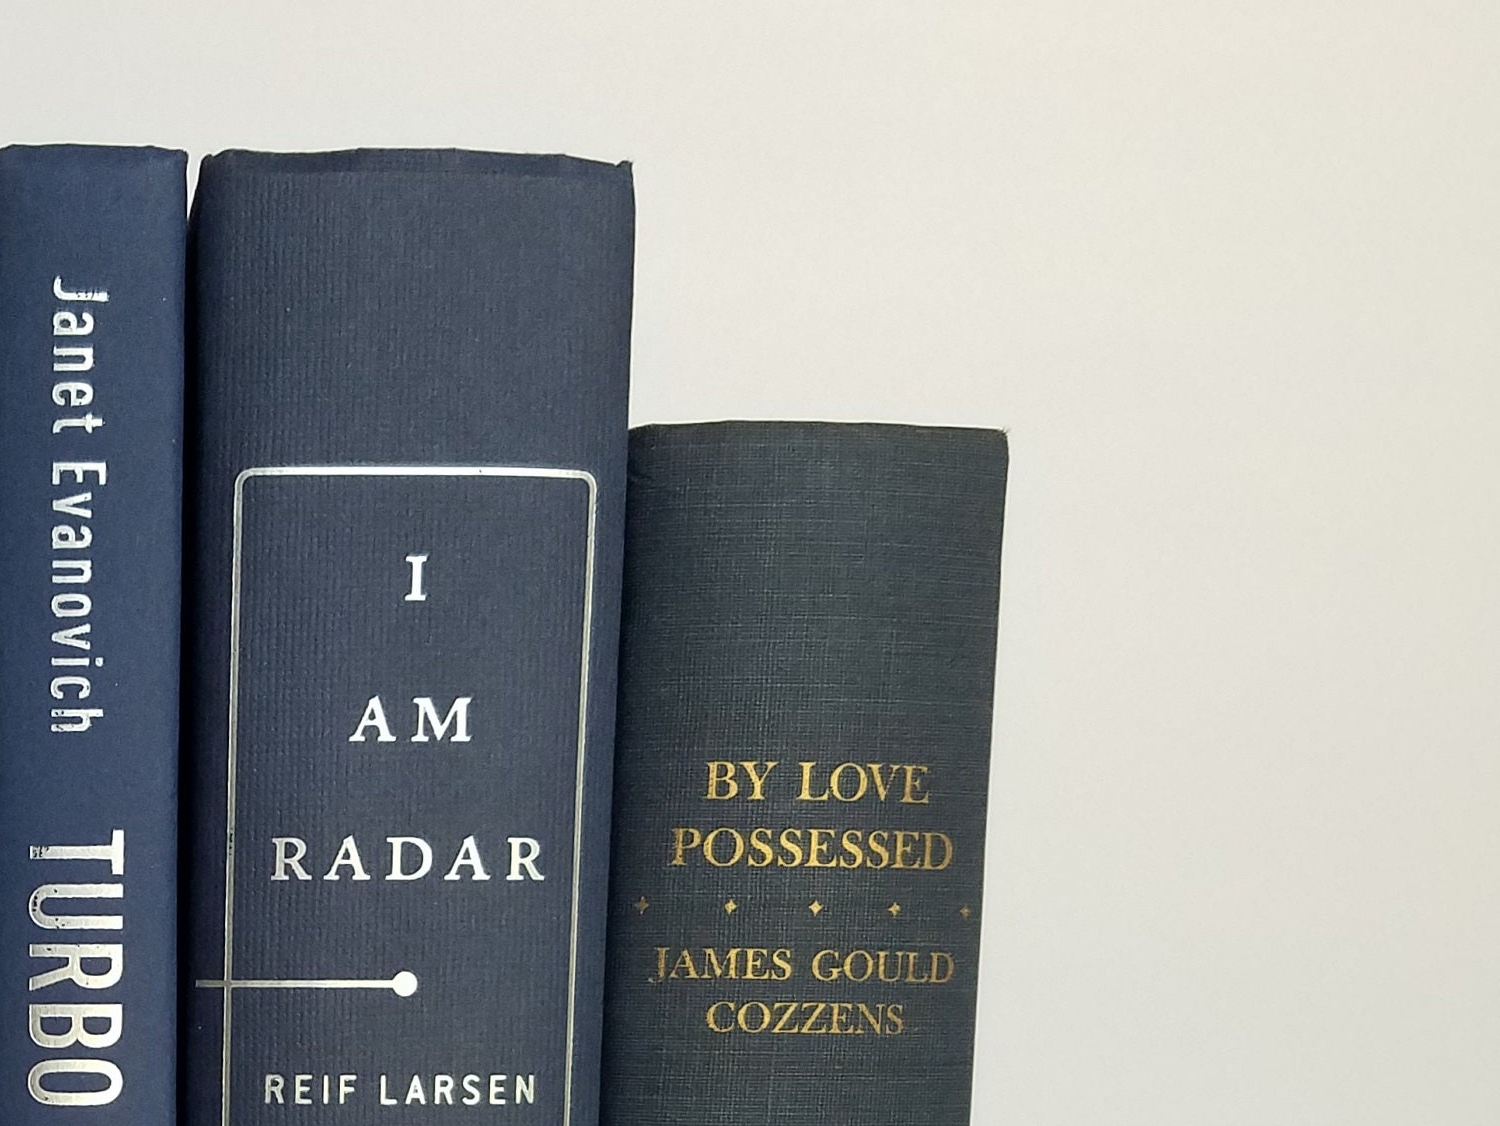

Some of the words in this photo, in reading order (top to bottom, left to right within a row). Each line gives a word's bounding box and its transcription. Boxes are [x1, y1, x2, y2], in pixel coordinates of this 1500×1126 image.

[51, 276, 109, 434] Janet
[50, 461, 107, 732] Evanovich
[404, 553, 428, 601] I
[348, 695, 472, 742] AM
[706, 761, 779, 800] BY
[797, 762, 930, 804] LOVE
[271, 835, 545, 881] RADAR
[668, 827, 953, 870] POSSESSED
[28, 829, 124, 1106] TURBO
[648, 947, 792, 984] JAMES
[811, 949, 955, 983] GOULD
[706, 1001, 905, 1035] COZZENS
[264, 1074, 357, 1104] REIF
[380, 1074, 535, 1105] LARSEN
